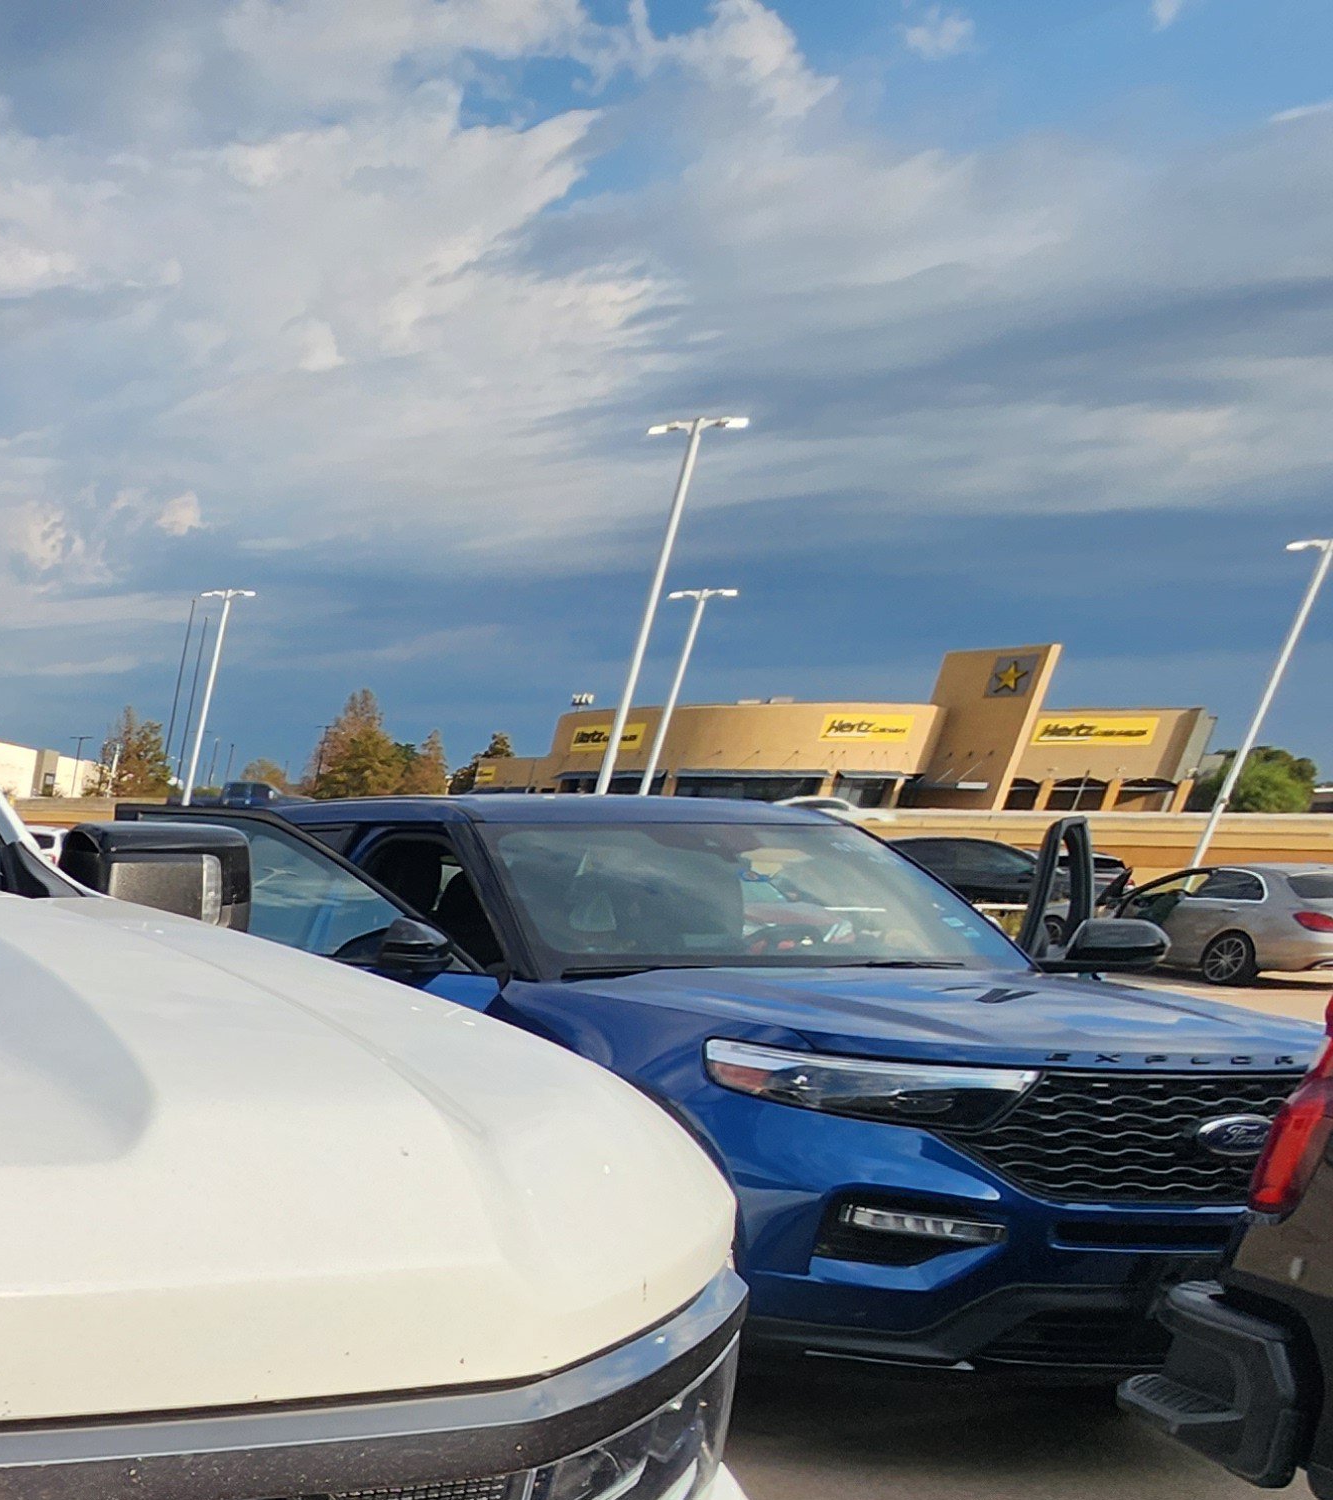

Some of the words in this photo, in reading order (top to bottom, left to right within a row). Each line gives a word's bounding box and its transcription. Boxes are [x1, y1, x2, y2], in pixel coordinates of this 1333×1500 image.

[826, 720, 875, 734] Hertz
[1040, 723, 1098, 737] Hertz
[1044, 1053, 1294, 1066] EXPLOR
[1223, 1124, 1269, 1144] Ford
